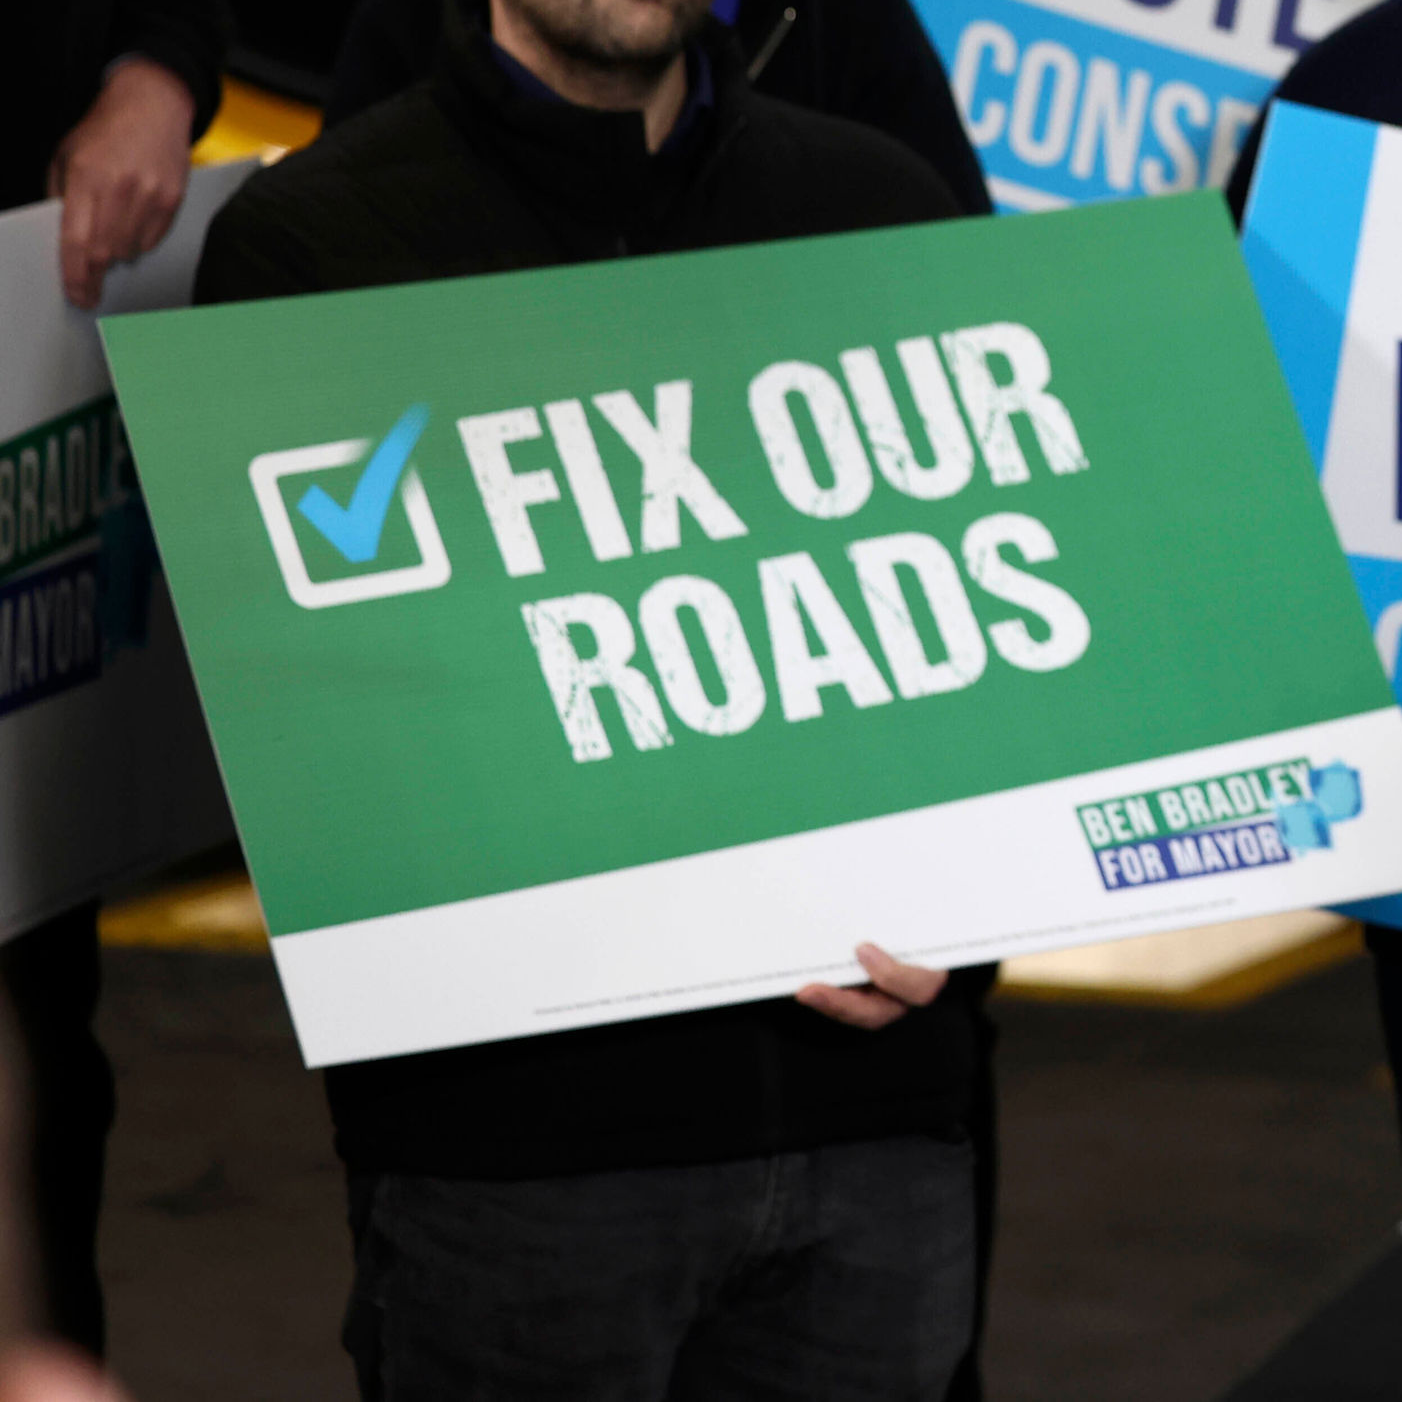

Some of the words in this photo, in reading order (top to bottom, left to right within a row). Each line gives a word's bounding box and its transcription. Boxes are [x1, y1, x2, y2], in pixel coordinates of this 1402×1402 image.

[456, 379, 749, 579] FIX
[748, 321, 1090, 520] OUR
[520, 512, 1092, 764] ROADS
[1080, 794, 1158, 848] BEN
[1159, 763, 1314, 831] BRADLEY
[1101, 843, 1169, 891] FOR
[1169, 823, 1287, 878] MAYOR
